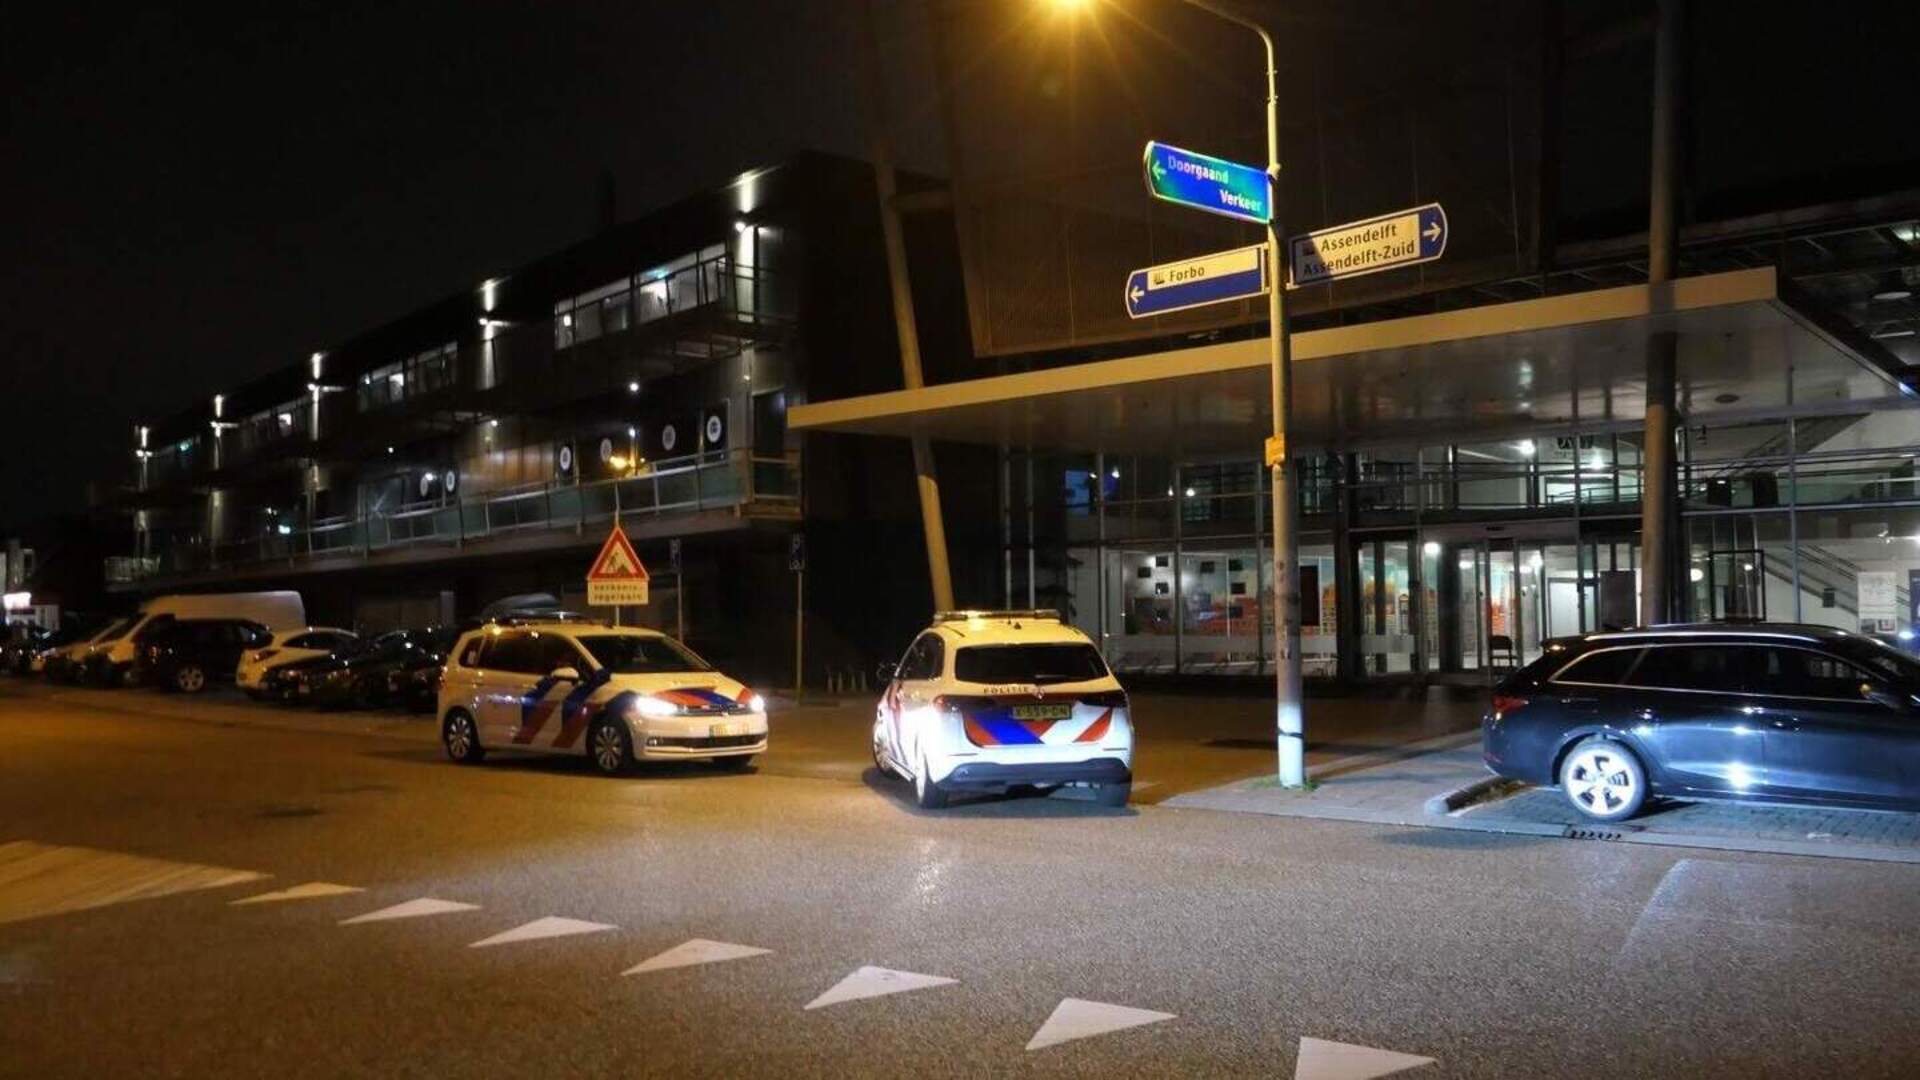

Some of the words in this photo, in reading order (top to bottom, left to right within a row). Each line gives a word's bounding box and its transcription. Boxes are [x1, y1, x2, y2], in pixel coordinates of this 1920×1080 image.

[1167, 155, 1229, 185] Doorgaand
[1219, 188, 1263, 212] Verkeer
[1321, 223, 1397, 253] Assendelft
[1303, 240, 1416, 277] Assendelft-Zuid
[1170, 266, 1205, 281] Forbo
[983, 686, 1028, 695] POLITIE
